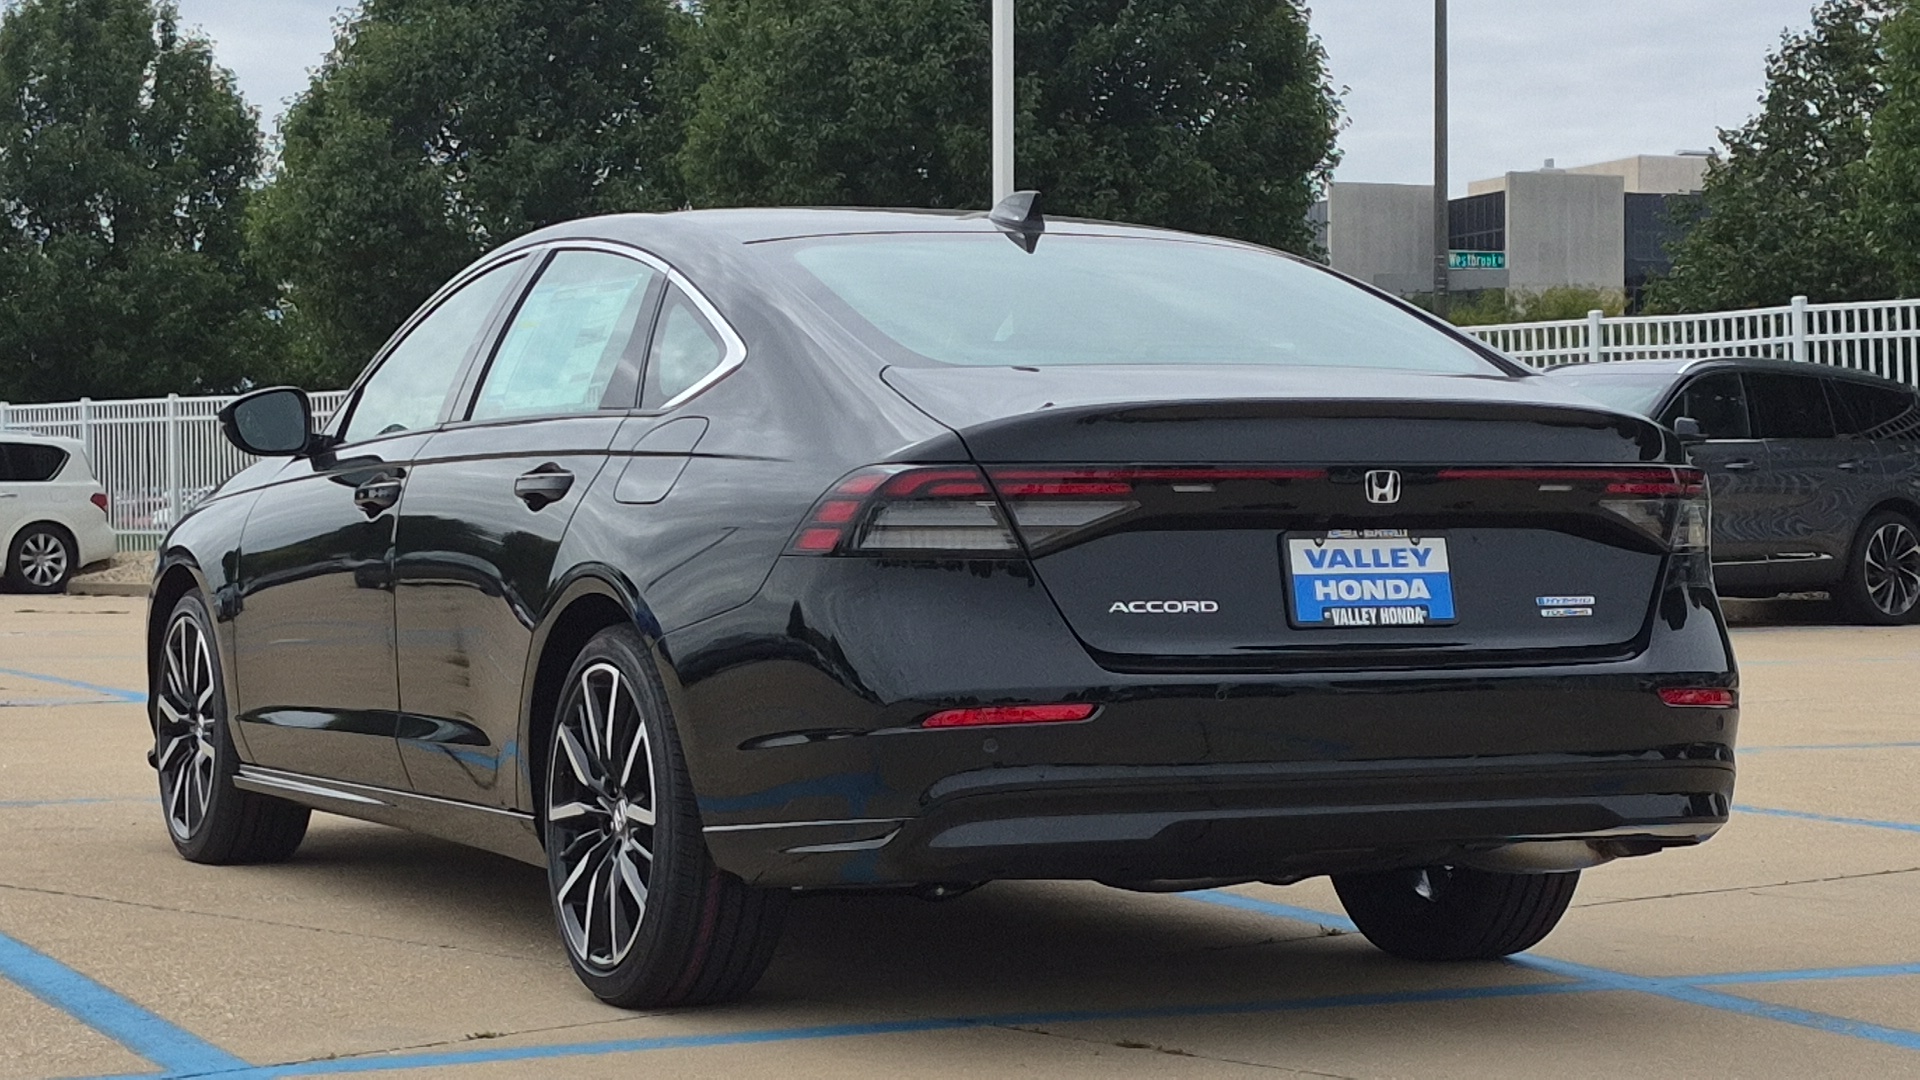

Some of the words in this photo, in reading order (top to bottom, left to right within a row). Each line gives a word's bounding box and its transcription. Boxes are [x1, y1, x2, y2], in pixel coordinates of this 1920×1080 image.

[1448, 253, 1498, 267] Westbrook
[1304, 548, 1432, 569] VALLEY
[1314, 578, 1432, 601] HONDA
[1108, 600, 1219, 613] ACCORD
[1332, 607, 1377, 626] VALLEY
[1380, 606, 1425, 625] HONDA
